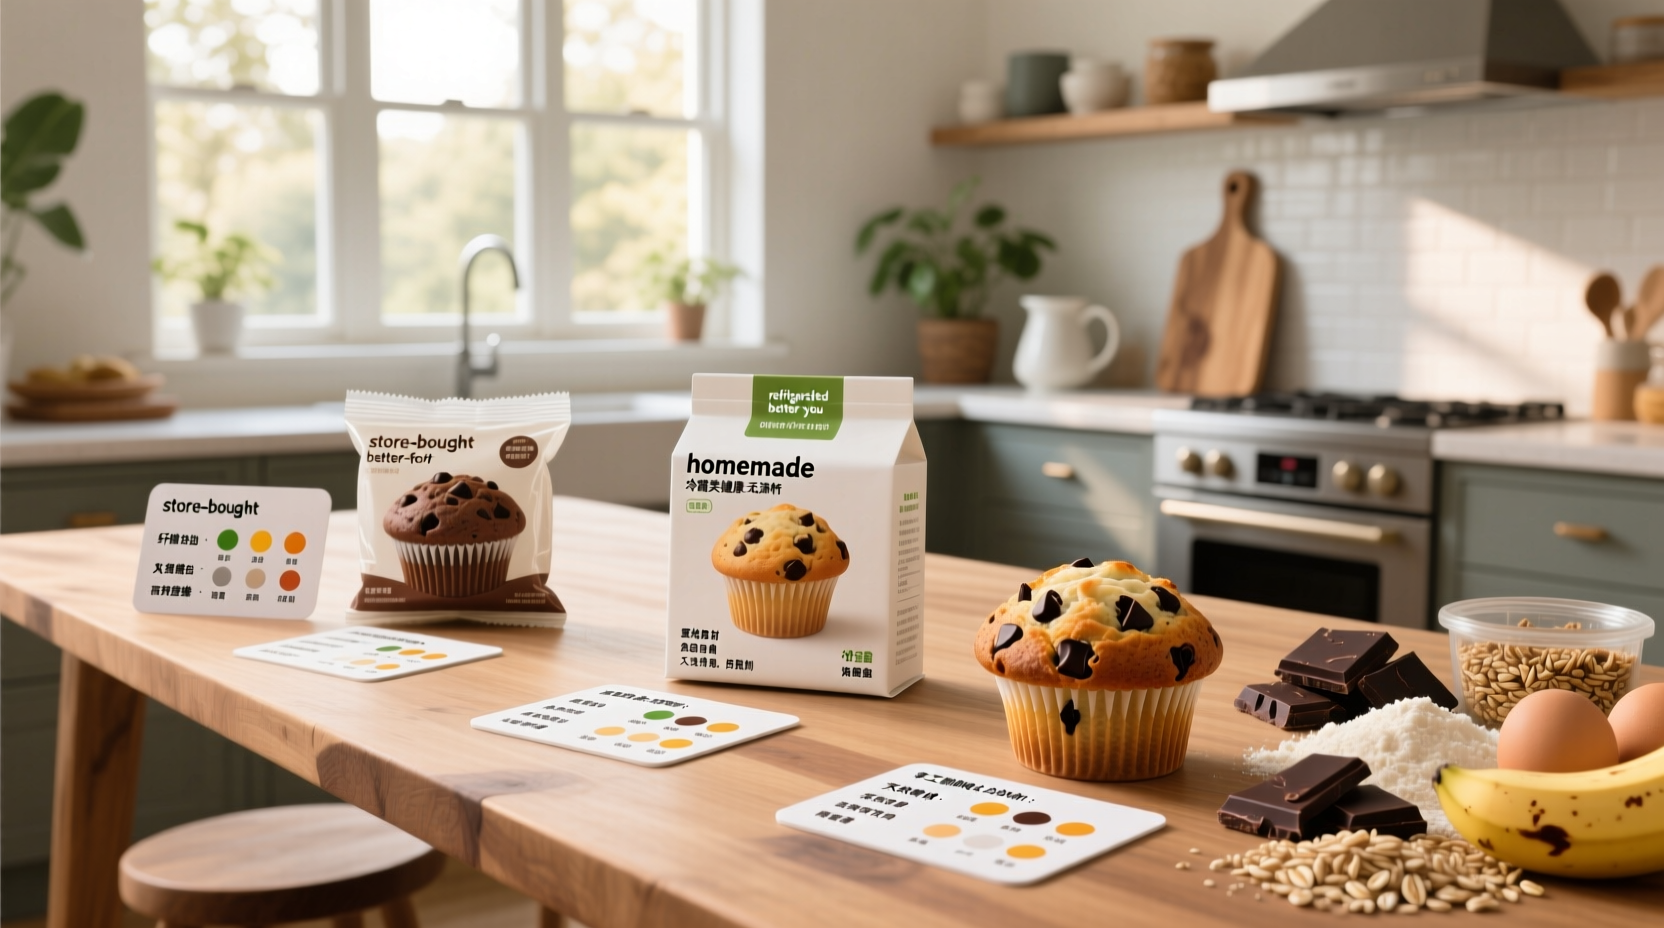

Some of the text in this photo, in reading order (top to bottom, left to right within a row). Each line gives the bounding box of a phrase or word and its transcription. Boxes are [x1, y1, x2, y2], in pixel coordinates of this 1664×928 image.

[802, 405, 824, 418] you
[369, 434, 475, 452] store-bought
[687, 452, 815, 478] homemade
[162, 498, 260, 518] store-bought
